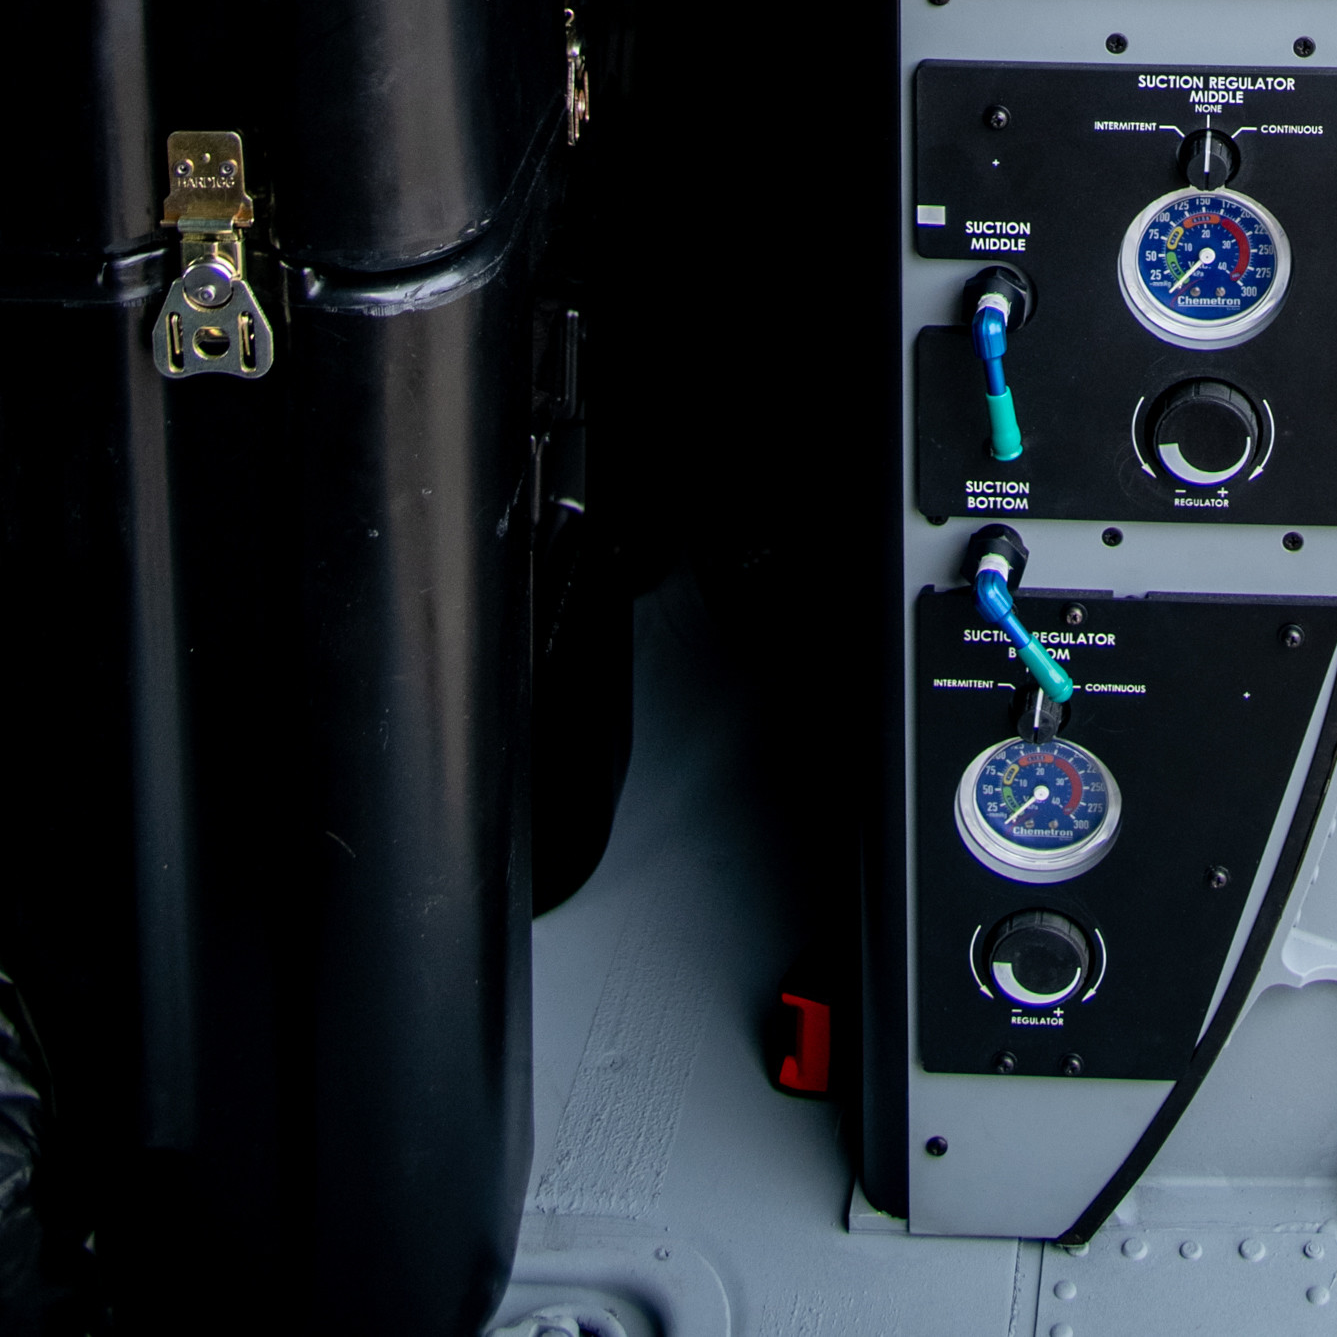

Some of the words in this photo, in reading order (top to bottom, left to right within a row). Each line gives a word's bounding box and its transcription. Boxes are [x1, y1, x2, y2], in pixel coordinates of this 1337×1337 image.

[1137, 74, 1204, 89] SUCTION
[1209, 76, 1296, 91] REGULATOR
[1189, 90, 1244, 104] MIDDLE
[1194, 103, 1222, 113] NONE
[1094, 121, 1157, 131] INTERMITTENT
[1260, 124, 1324, 135] CONTINUOUS
[965, 220, 1031, 235] SUCTION
[1149, 229, 1159, 239] 75
[970, 237, 1026, 251] MIDDLE
[1259, 245, 1274, 255] 250
[1145, 251, 1156, 261] 50
[1150, 270, 1161, 280] 25
[1256, 268, 1271, 278] 275
[1241, 286, 1257, 297] 300
[1178, 296, 1241, 306] Chemetron
[965, 480, 1030, 494] SUCTION
[967, 496, 1029, 510] BOTTOM
[1174, 497, 1229, 508] REGULATOR
[964, 629, 1012, 643] SUCTI
[933, 678, 994, 689] INTERMITTENT
[1084, 683, 1147, 694] CONTINUOUS
[1013, 826, 1074, 836] Chemetron
[1011, 1016, 1064, 1026] REGULATOR
